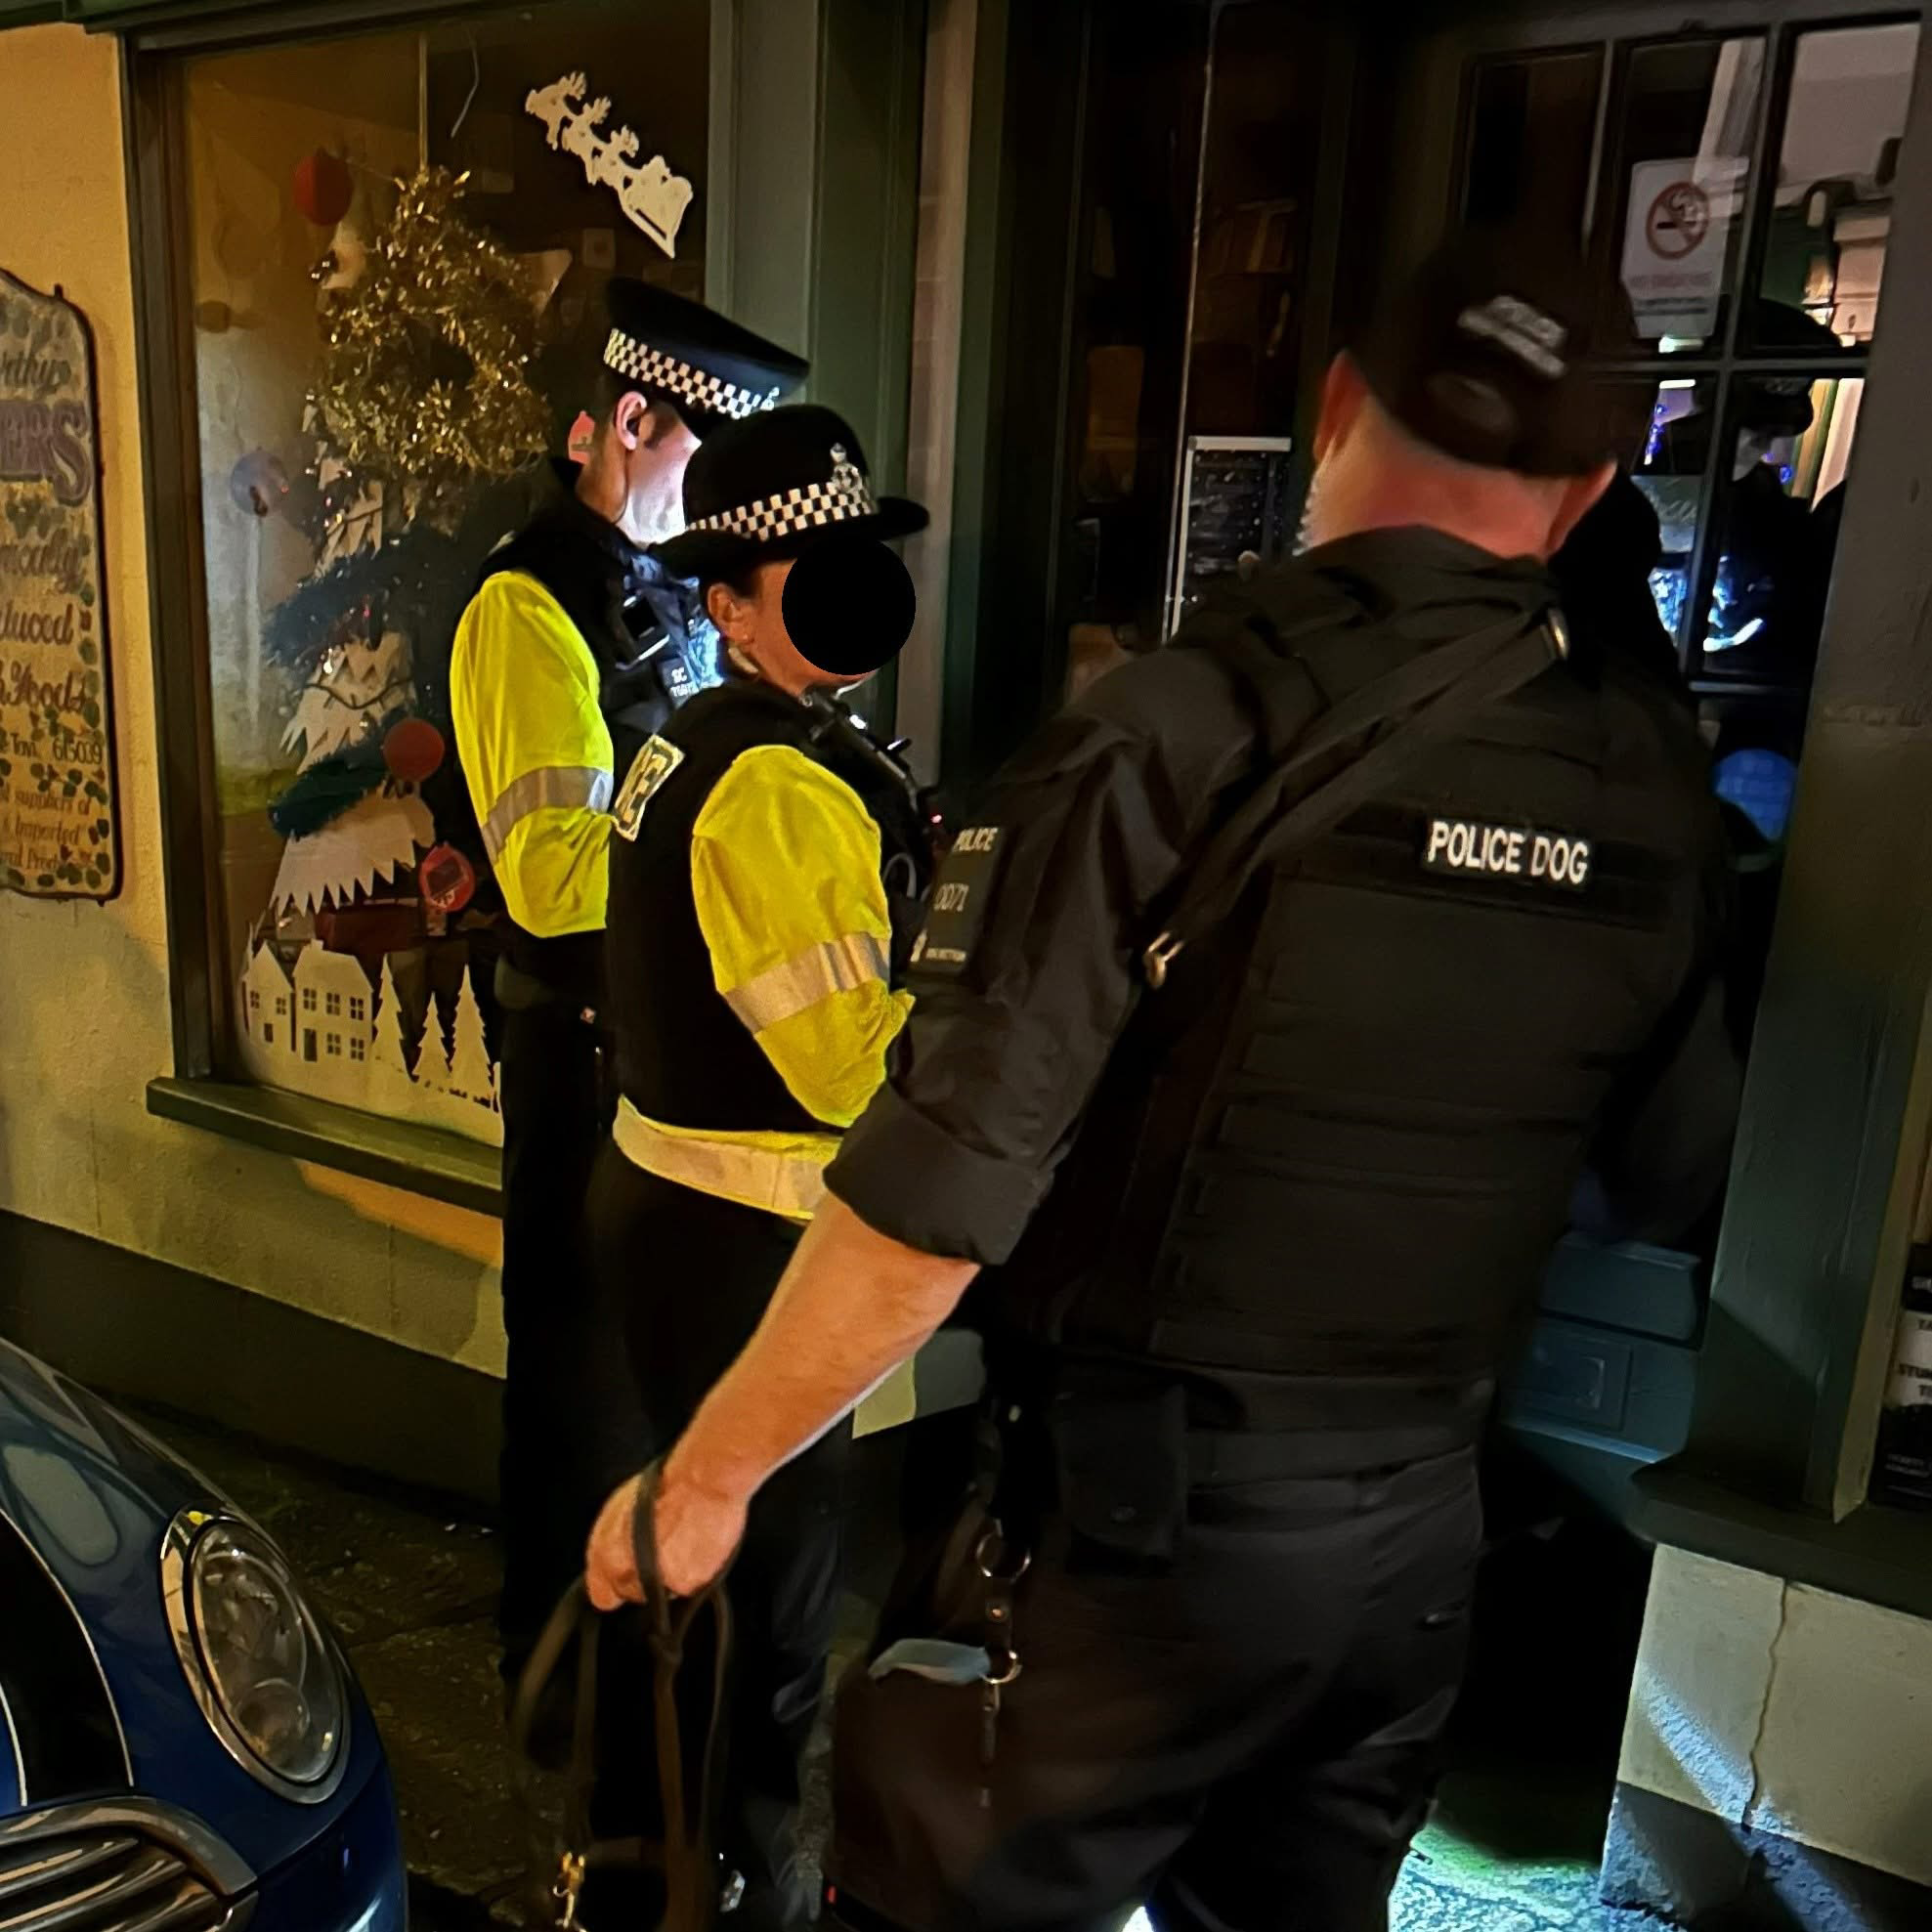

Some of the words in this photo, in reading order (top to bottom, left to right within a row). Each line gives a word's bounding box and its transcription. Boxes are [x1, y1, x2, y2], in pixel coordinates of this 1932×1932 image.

[952, 827, 999, 853] POLICE
[1427, 821, 1525, 873] POLICE
[1530, 836, 1589, 884] DOG
